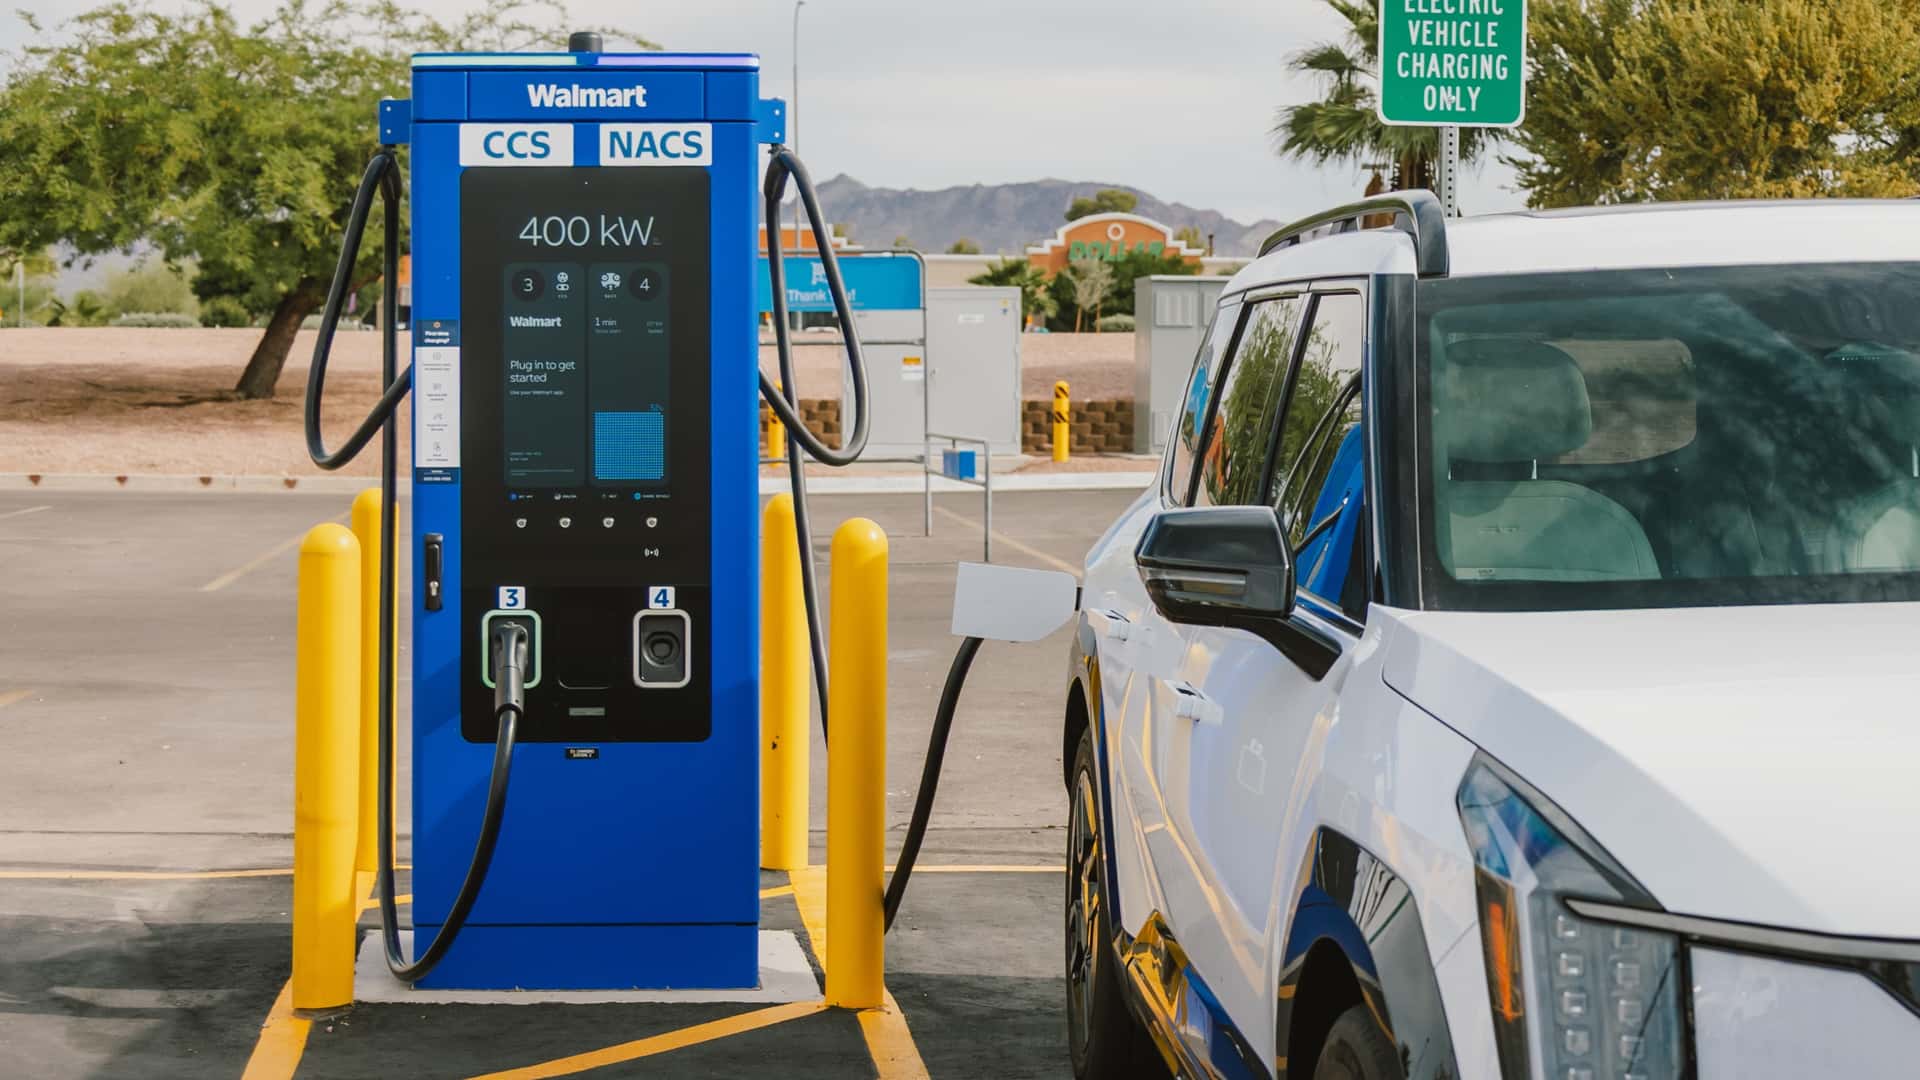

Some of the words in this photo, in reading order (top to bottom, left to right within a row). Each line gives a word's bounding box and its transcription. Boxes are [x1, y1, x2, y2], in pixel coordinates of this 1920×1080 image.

[1408, 20, 1499, 47] VEHICLE
[1397, 52, 1508, 80] CHARGING
[528, 84, 647, 108] Walmart
[1423, 85, 1481, 112] ONLY
[483, 130, 551, 159] CCS
[609, 130, 703, 159] NACS
[519, 215, 590, 247] 400
[600, 214, 655, 247] kW
[523, 278, 534, 292] 3
[639, 278, 650, 292] 4
[788, 289, 826, 301] Thank
[510, 316, 562, 327] Walmart
[510, 360, 533, 372] Plug
[534, 360, 544, 370] in
[546, 361, 557, 370] to
[558, 361, 576, 373] get
[510, 373, 548, 383] started
[505, 588, 519, 608] 3
[654, 588, 670, 608] 4
